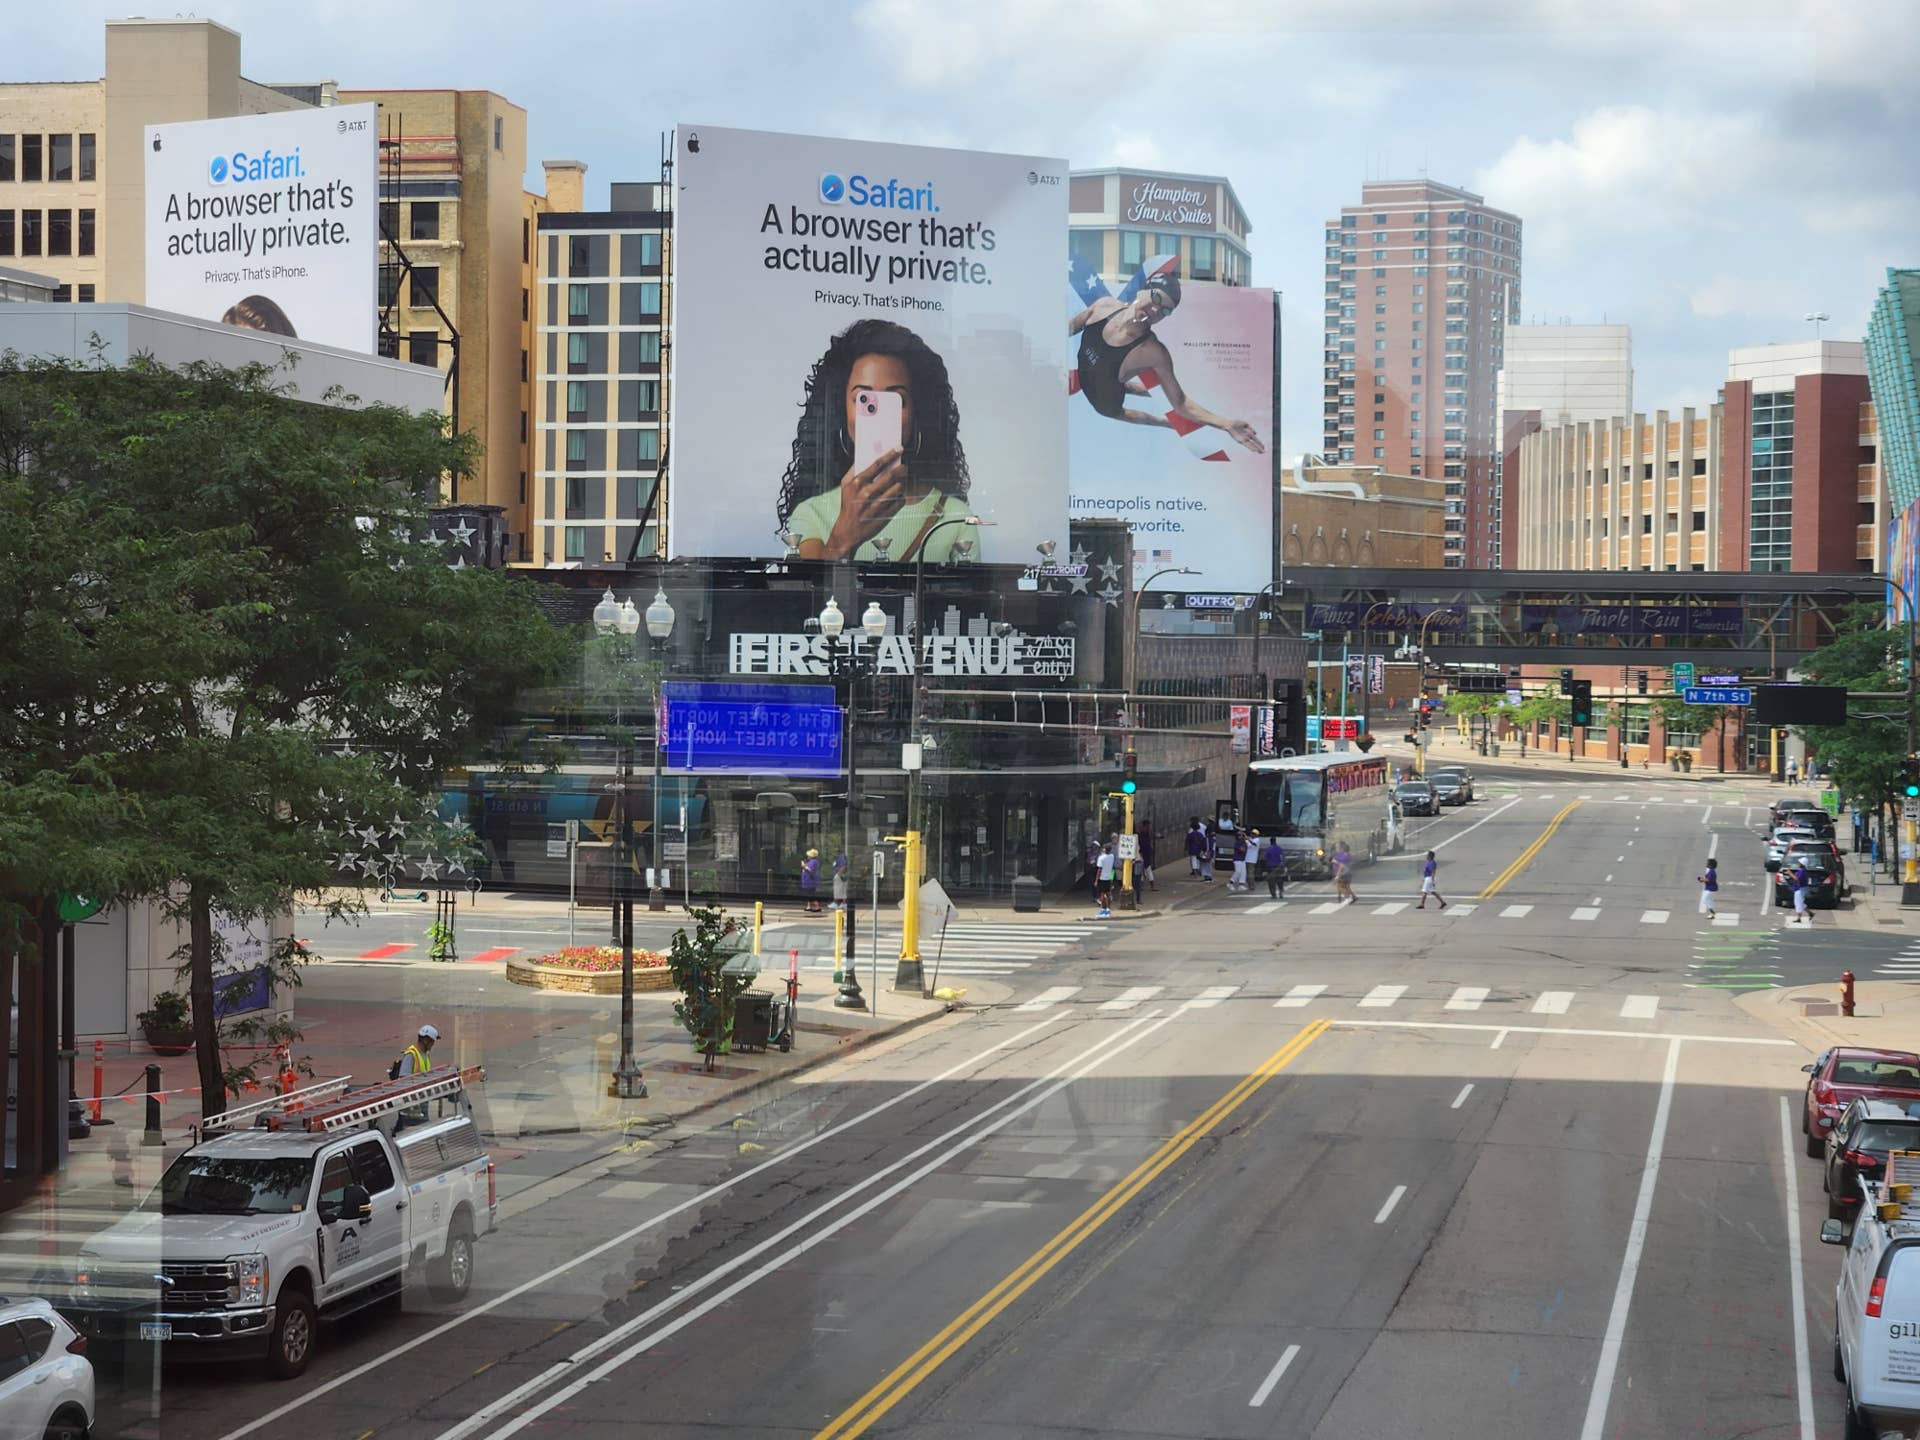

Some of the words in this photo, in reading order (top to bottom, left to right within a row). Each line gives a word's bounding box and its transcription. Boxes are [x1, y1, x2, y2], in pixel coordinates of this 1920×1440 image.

[348, 119, 367, 132] AT&T
[231, 147, 306, 183] Safari.
[1040, 174, 1060, 185] AT&T
[165, 192, 181, 223] A
[187, 189, 282, 220] browser
[287, 179, 354, 212] that's
[849, 175, 941, 213] Safari.
[1133, 182, 1207, 205] Hampton
[1127, 203, 1162, 223] Inn
[1163, 210, 1174, 224] &
[1172, 206, 1212, 225] Suites
[167, 223, 256, 257] actually
[262, 217, 350, 255] private.
[760, 203, 783, 234] A
[791, 206, 911, 245] browser
[918, 218, 996, 251] that's
[204, 267, 241, 284] Privacy.
[242, 266, 270, 280] That's
[272, 265, 308, 280] iPhone.
[763, 245, 880, 283] actually
[888, 250, 992, 285] private.
[815, 290, 861, 307] Privacy.
[863, 293, 899, 308] That's
[901, 295, 945, 312] iPhone.
[1068, 494, 1151, 514] inneapolis
[1156, 496, 1207, 512] native.
[1124, 517, 1185, 533] avorite.
[1023, 567, 1040, 580] 217
[1188, 596, 1252, 607] OUTFROT
[1311, 604, 1355, 626] Prince
[1580, 608, 1629, 630] Purple
[1640, 609, 1681, 628] Rain
[876, 635, 1024, 675] AVENUE
[1055, 637, 1071, 658] St
[1033, 659, 1071, 681] entry
[1689, 691, 1698, 701] N
[1703, 691, 1726, 702] 7th
[1731, 692, 1746, 702] St
[1121, 836, 1134, 844] ONE
